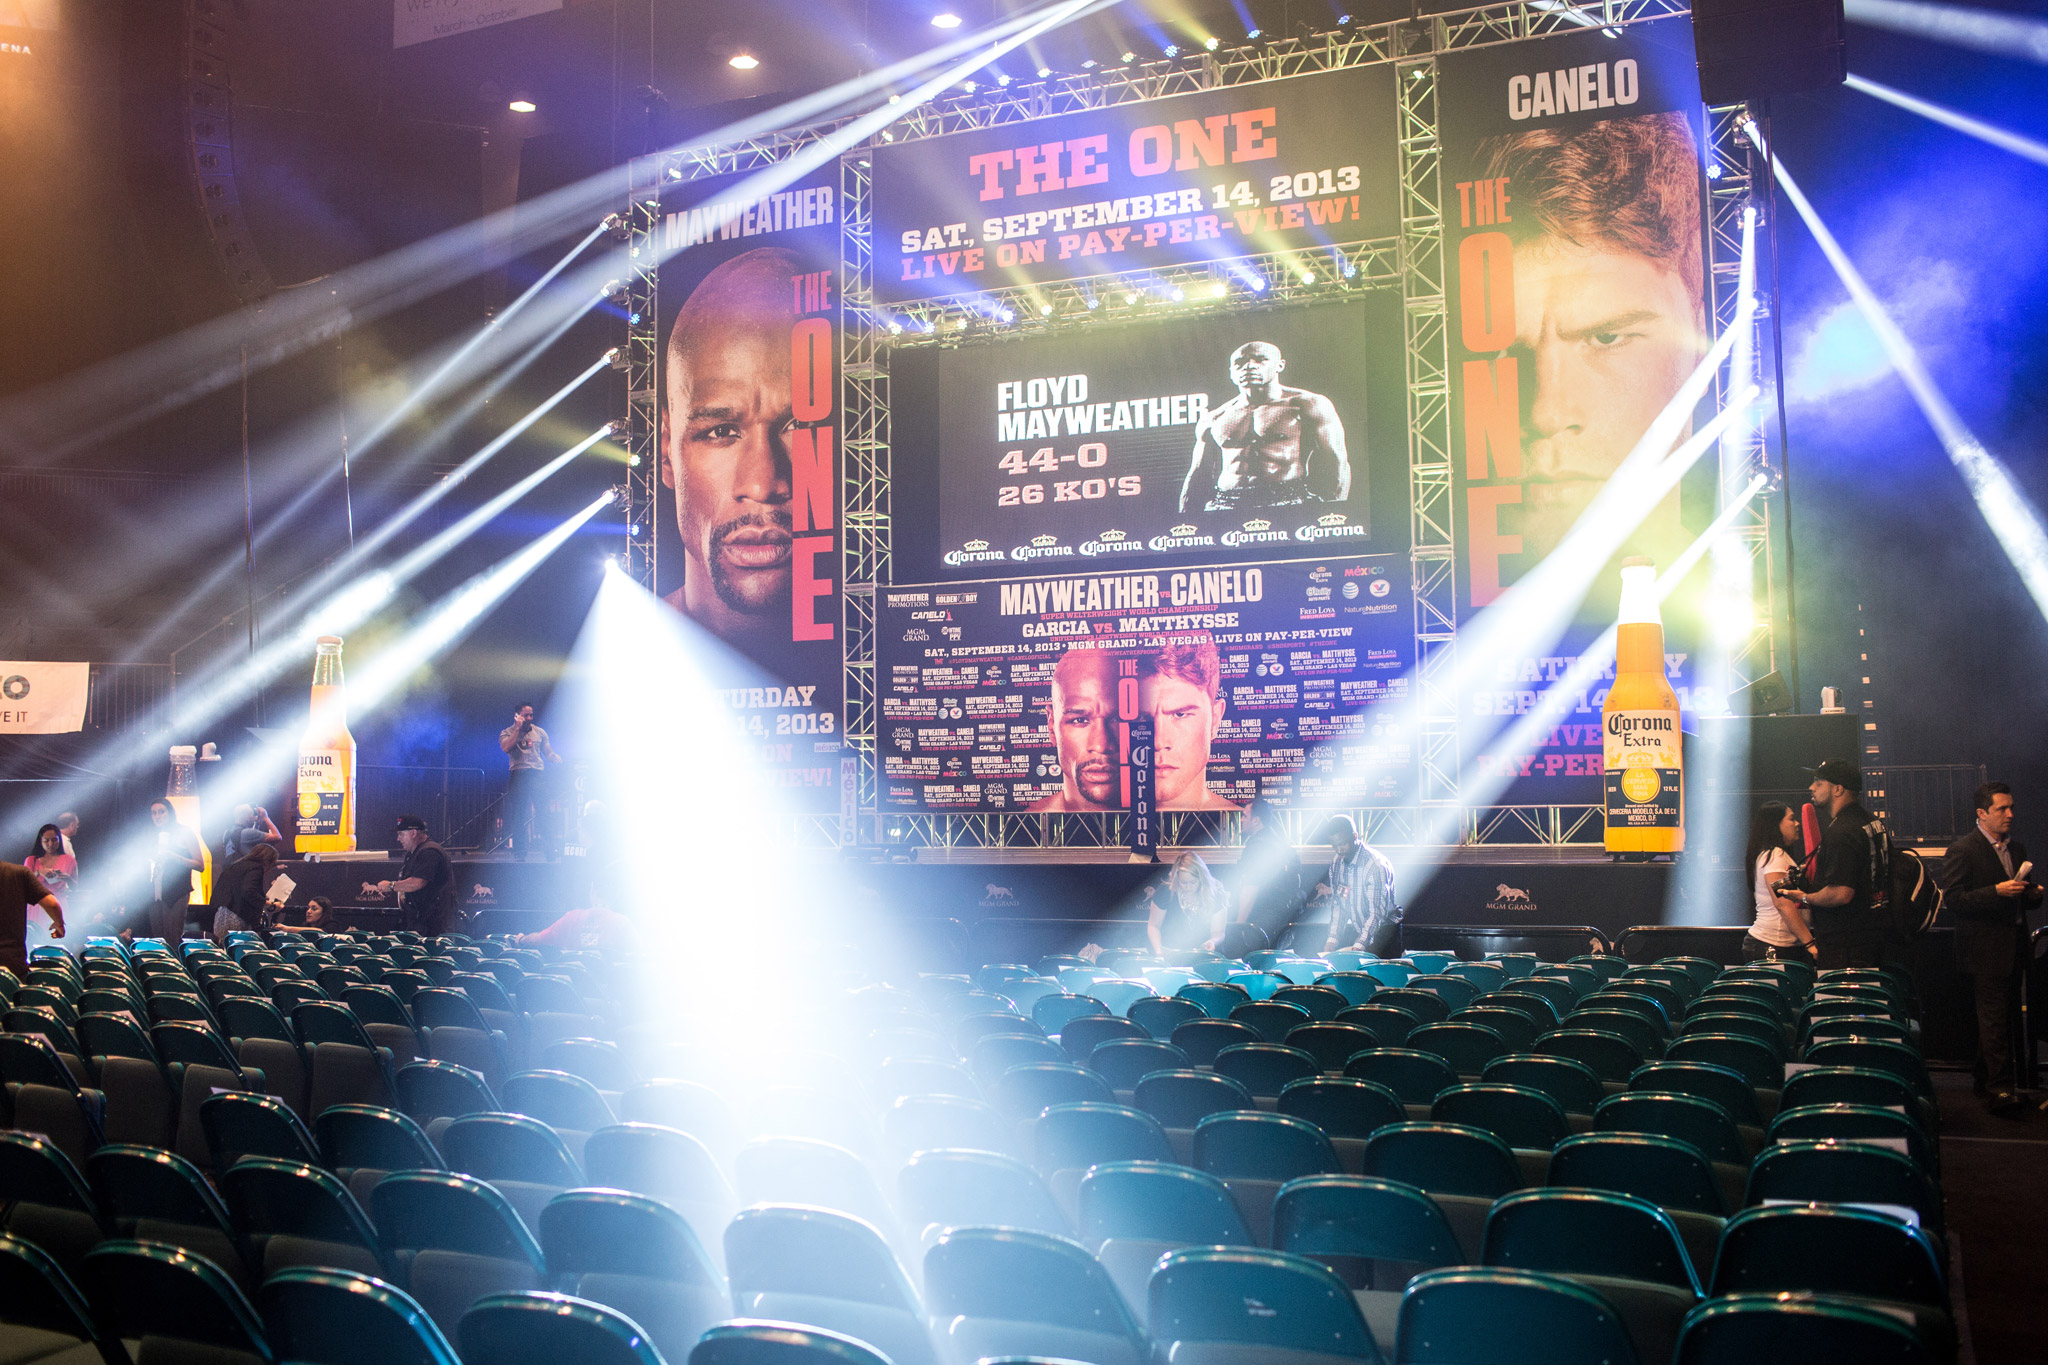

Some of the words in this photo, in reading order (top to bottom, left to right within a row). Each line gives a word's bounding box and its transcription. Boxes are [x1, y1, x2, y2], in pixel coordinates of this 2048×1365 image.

[433, 19, 465, 35] March
[476, 7, 518, 26] October
[1508, 58, 1639, 121] CANELO
[970, 133, 1109, 202] THE
[1128, 107, 1278, 177] ONE
[901, 223, 974, 253] SAT.,
[983, 188, 1203, 242] SEPTEMBER
[1212, 181, 1260, 208] 14,
[1270, 166, 1361, 201] 2013
[1455, 177, 1512, 228] THE
[666, 186, 834, 250] MAYWEATHER
[901, 248, 984, 281] LIVE
[996, 239, 1047, 268] ON
[1059, 195, 1360, 260] PAY-PER-VIEW!
[791, 270, 832, 314] THE
[998, 374, 1088, 411] FLOYD
[998, 393, 1209, 442] MAYWEATHER
[1459, 231, 1524, 608] ONE
[999, 442, 1107, 475] 44-0
[791, 317, 834, 642] ONE
[998, 484, 1045, 507] 26
[1054, 475, 1142, 502] KO'S
[1148, 535, 1215, 551] Corona
[1221, 530, 1289, 547] Corona
[1295, 525, 1366, 542] Corona
[944, 550, 1006, 566] Corona
[1011, 545, 1074, 561] Corona
[1079, 540, 1143, 557] Corona
[1310, 570, 1332, 579] Corona
[888, 593, 929, 602] MAYWEATHER
[936, 596, 958, 604] GOLDEN
[966, 594, 978, 602] BOY
[1001, 575, 1159, 615] MAYWEATHER
[1170, 568, 1263, 606] CANELO
[912, 611, 946, 620] CANELO
[1066, 608, 1126, 618] WELTERWEIGHT
[1129, 608, 1156, 616] WORLD
[1158, 604, 1218, 614] CHAMPIONSHIP
[1022, 620, 1090, 638] GARCIA
[1093, 623, 1116, 634] VS.
[1119, 612, 1239, 632] MATTHYSSE
[924, 648, 949, 658] SAT.,
[952, 645, 1015, 656] SEPTEMBER
[1018, 644, 1032, 654] 14,
[1035, 643, 1060, 652] 2013
[1068, 641, 1096, 650] MGM
[1098, 639, 1136, 649] GRAND
[1144, 637, 1166, 647] LAS
[1169, 636, 1208, 646] VEGAS
[1215, 633, 1242, 644] LIVE
[1246, 632, 1262, 642] ON
[1264, 627, 1353, 641] PAY-PER-VIEW
[1290, 651, 1312, 660] GARCIA
[1322, 648, 1356, 658] MATTHYSSE
[1118, 660, 1138, 676] THE
[1230, 654, 1249, 662] CANELO
[0, 675, 30, 700] O
[1234, 686, 1254, 694] GARCIA
[1340, 680, 1378, 690] MAYWEATHER
[17, 712, 28, 722] IT
[776, 713, 835, 735] 2013
[1608, 713, 1673, 738] Corona
[1624, 733, 1662, 746] Extra
[299, 755, 332, 766] orona
[1132, 746, 1151, 847] Corona
